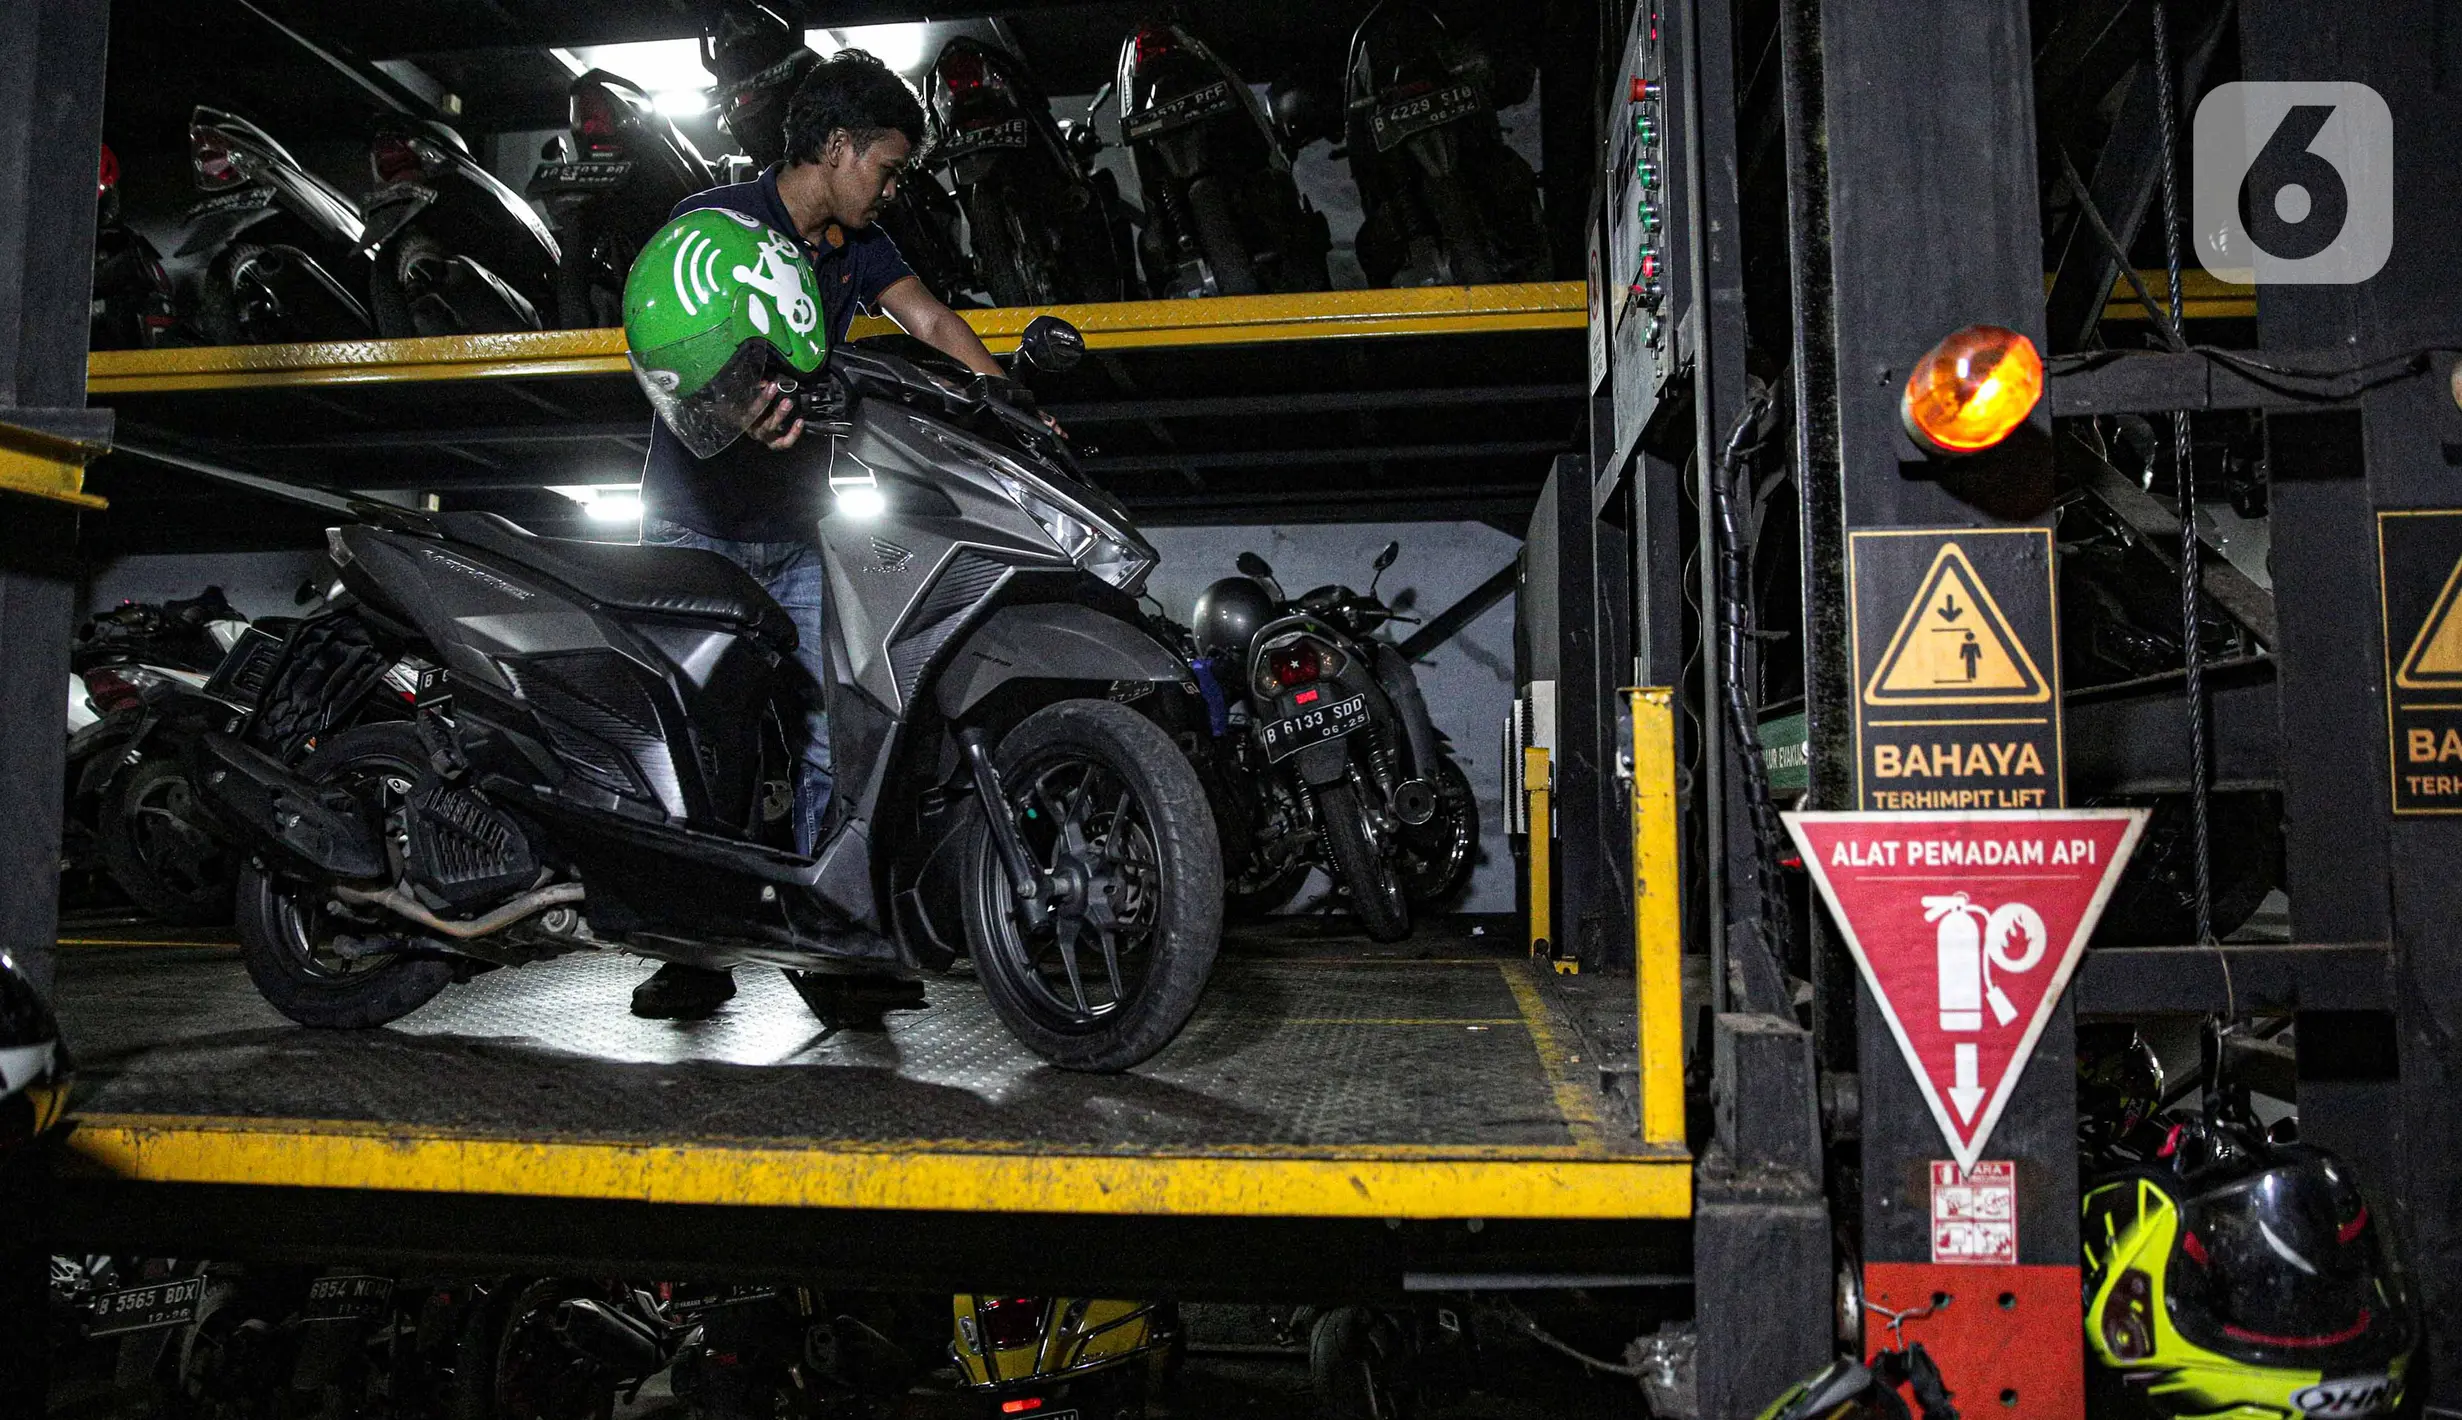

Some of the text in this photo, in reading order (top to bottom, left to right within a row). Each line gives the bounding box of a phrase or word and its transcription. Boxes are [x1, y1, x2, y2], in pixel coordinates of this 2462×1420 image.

[1267, 698, 1363, 745] B 6133 SDD
[1874, 742, 2046, 778] BAHAYA
[1872, 788, 2046, 810] TERHIMPIT LIFT
[1831, 838, 2096, 867] ALAT PEMADAM API
[99, 1283, 196, 1316] B 5565 BDX
